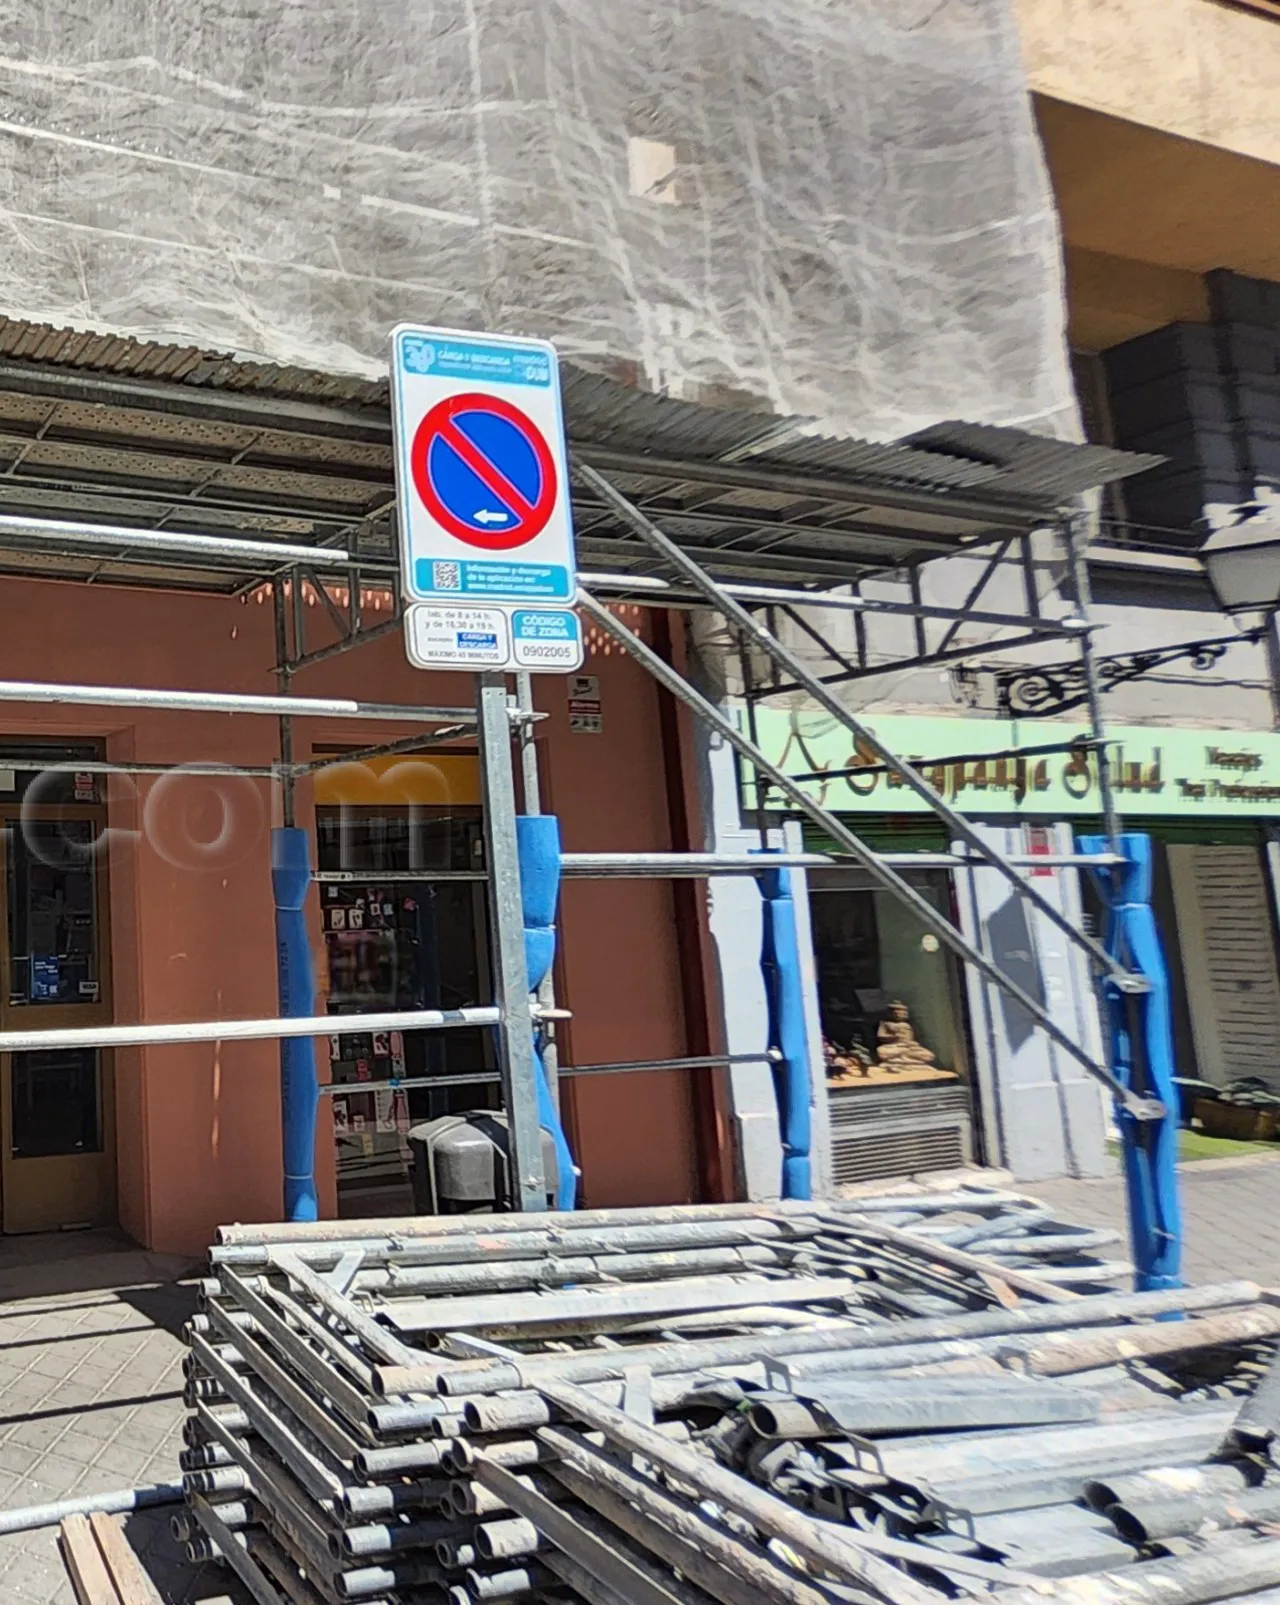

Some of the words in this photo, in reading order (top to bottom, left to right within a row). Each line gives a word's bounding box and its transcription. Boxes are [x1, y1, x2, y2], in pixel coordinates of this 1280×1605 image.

[445, 611, 455, 619] de
[522, 614, 567, 627] CÓDIGO
[432, 620, 443, 629] de
[521, 626, 537, 637] DE
[538, 627, 569, 638] ZONA
[522, 645, 571, 659] 0902005
